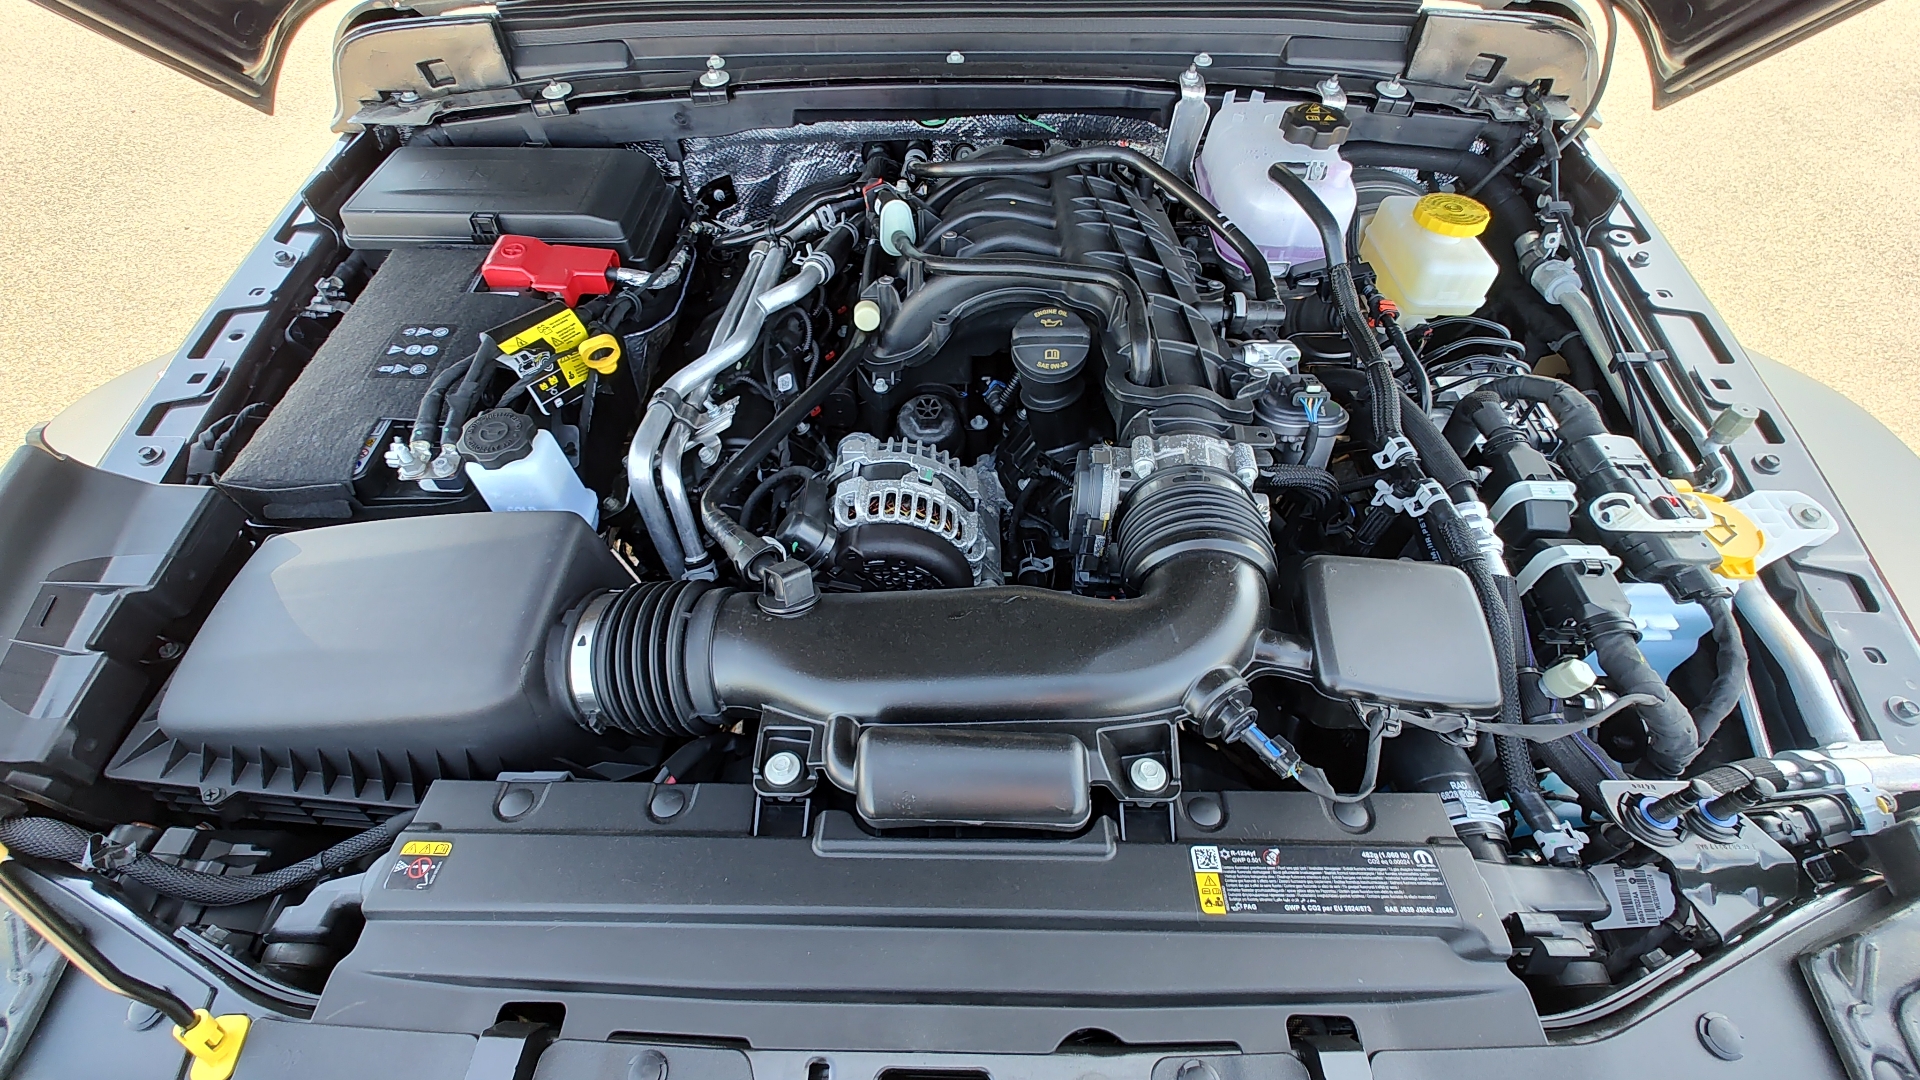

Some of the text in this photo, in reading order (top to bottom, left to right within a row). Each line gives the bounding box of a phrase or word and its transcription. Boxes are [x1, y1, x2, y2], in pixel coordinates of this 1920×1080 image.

[1034, 309, 1068, 318] ENGINE OIL
[1037, 361, 1050, 369] SAE
[1450, 781, 1467, 790] RAD
